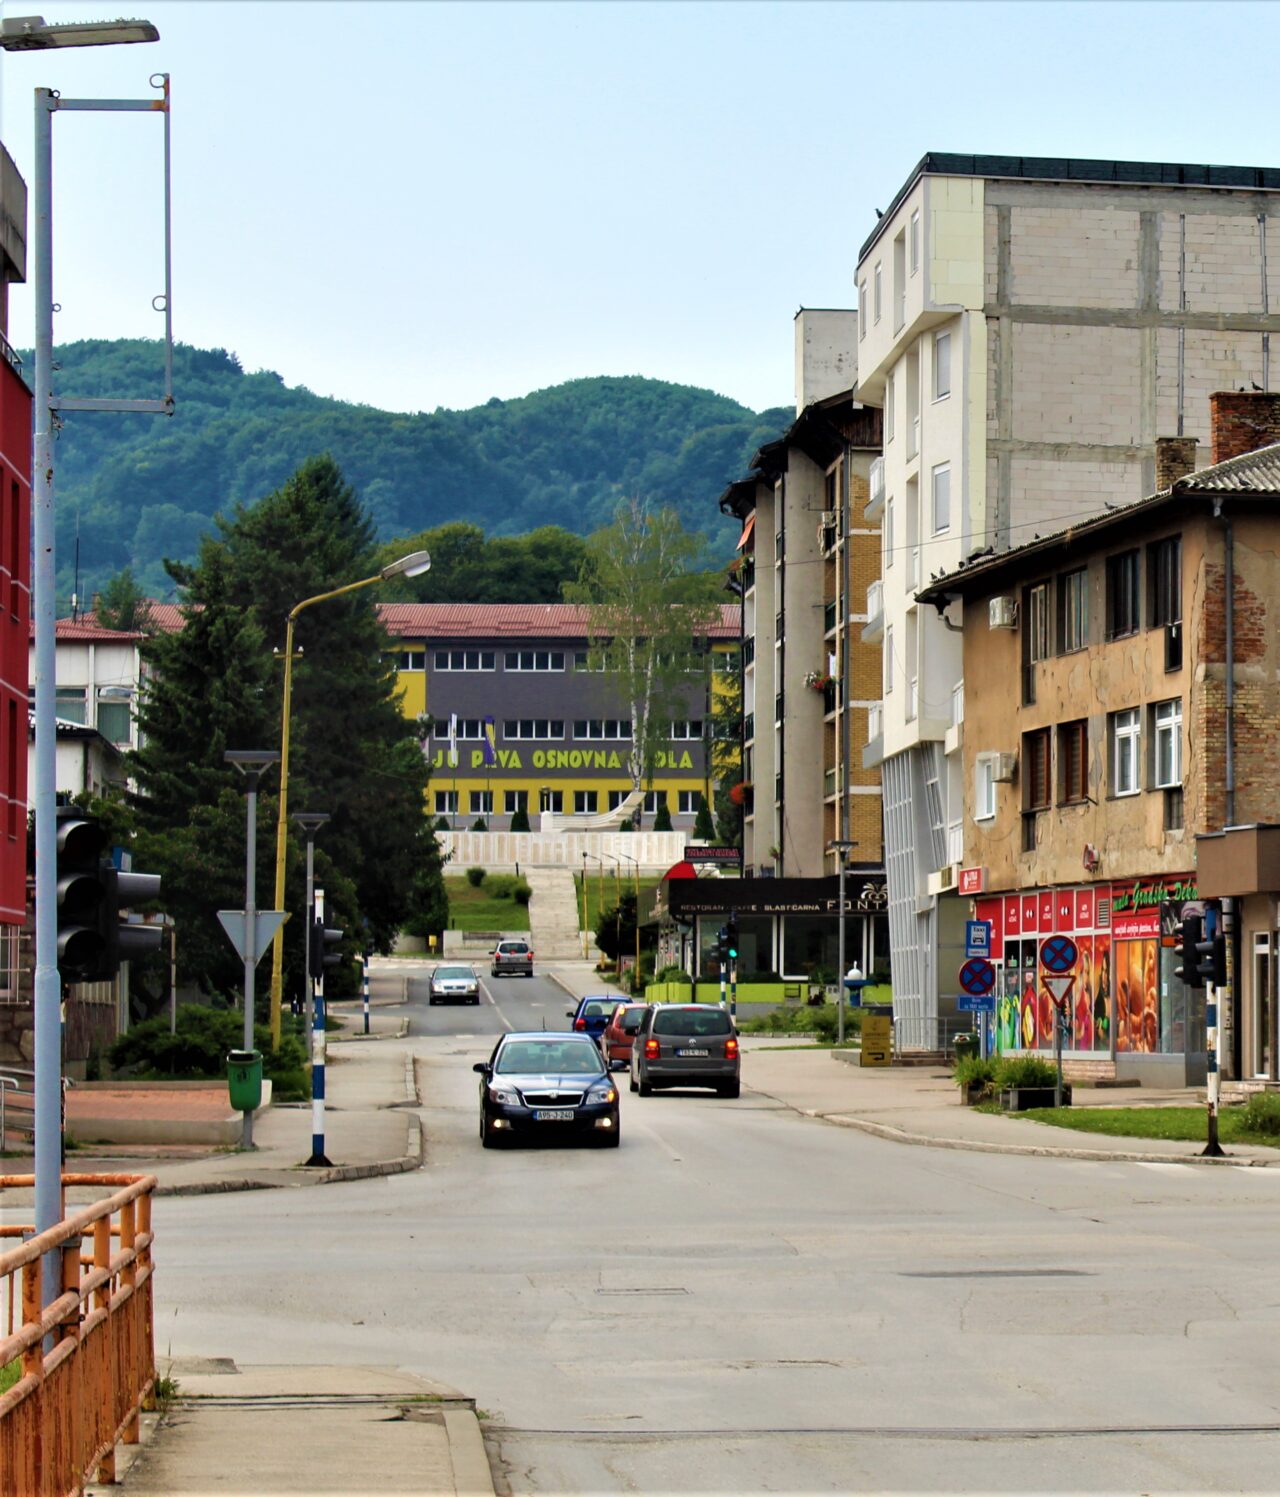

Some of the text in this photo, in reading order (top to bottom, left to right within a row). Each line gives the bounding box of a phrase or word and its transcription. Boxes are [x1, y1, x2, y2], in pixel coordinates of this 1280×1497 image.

[471, 749, 522, 769] PVA
[532, 749, 622, 769] OSNOVNA
[630, 749, 693, 769] OLA
[827, 899, 889, 910] FONT
